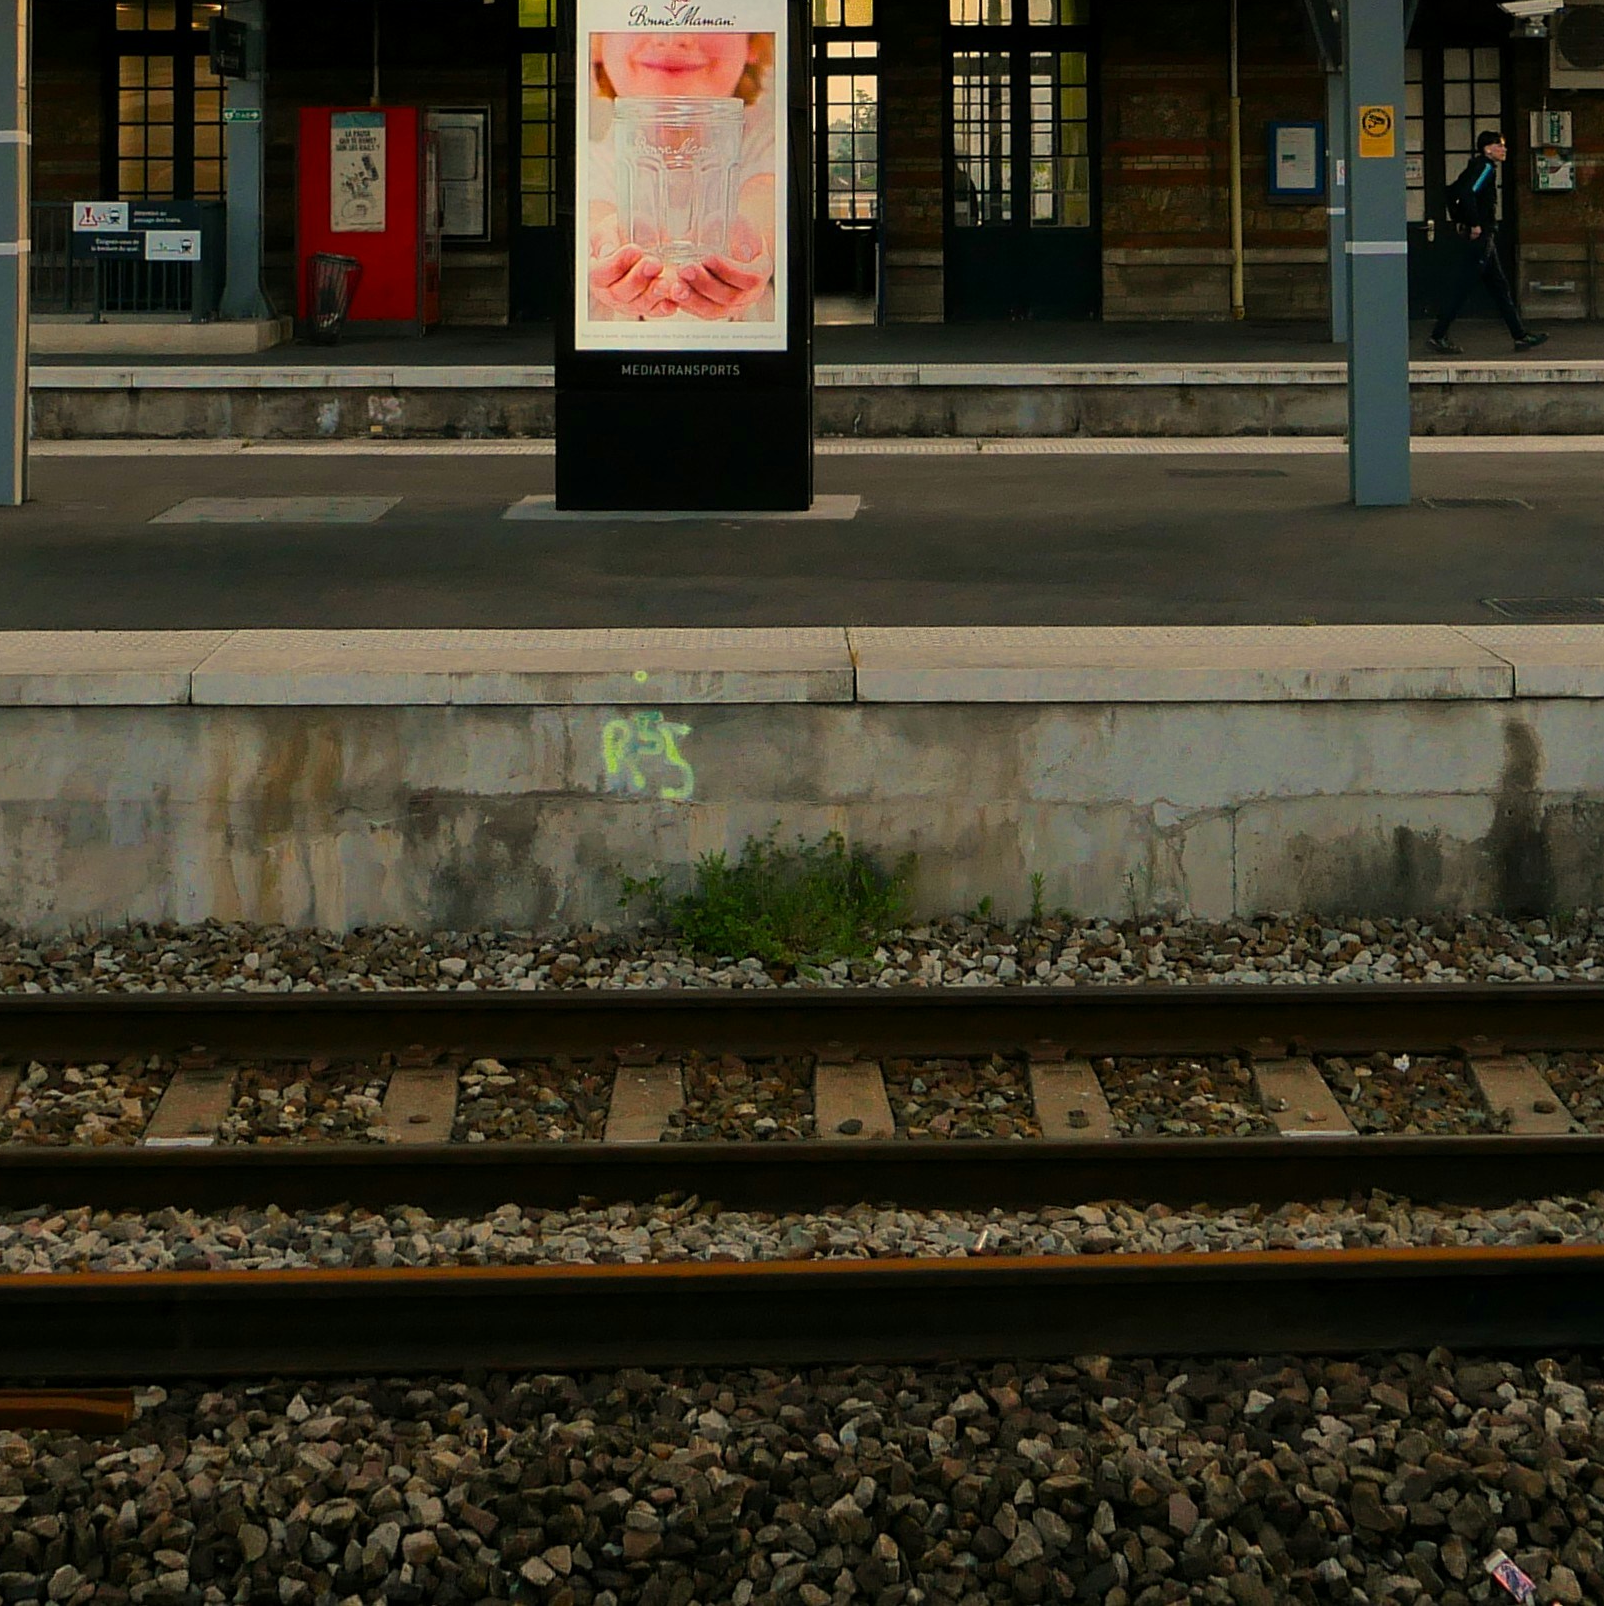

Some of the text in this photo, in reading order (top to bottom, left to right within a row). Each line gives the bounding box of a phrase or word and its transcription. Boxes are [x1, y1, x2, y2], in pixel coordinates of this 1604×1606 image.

[628, 4, 734, 27] Bonne Maman
[621, 364, 740, 376] MEDIATRANSPORTS
